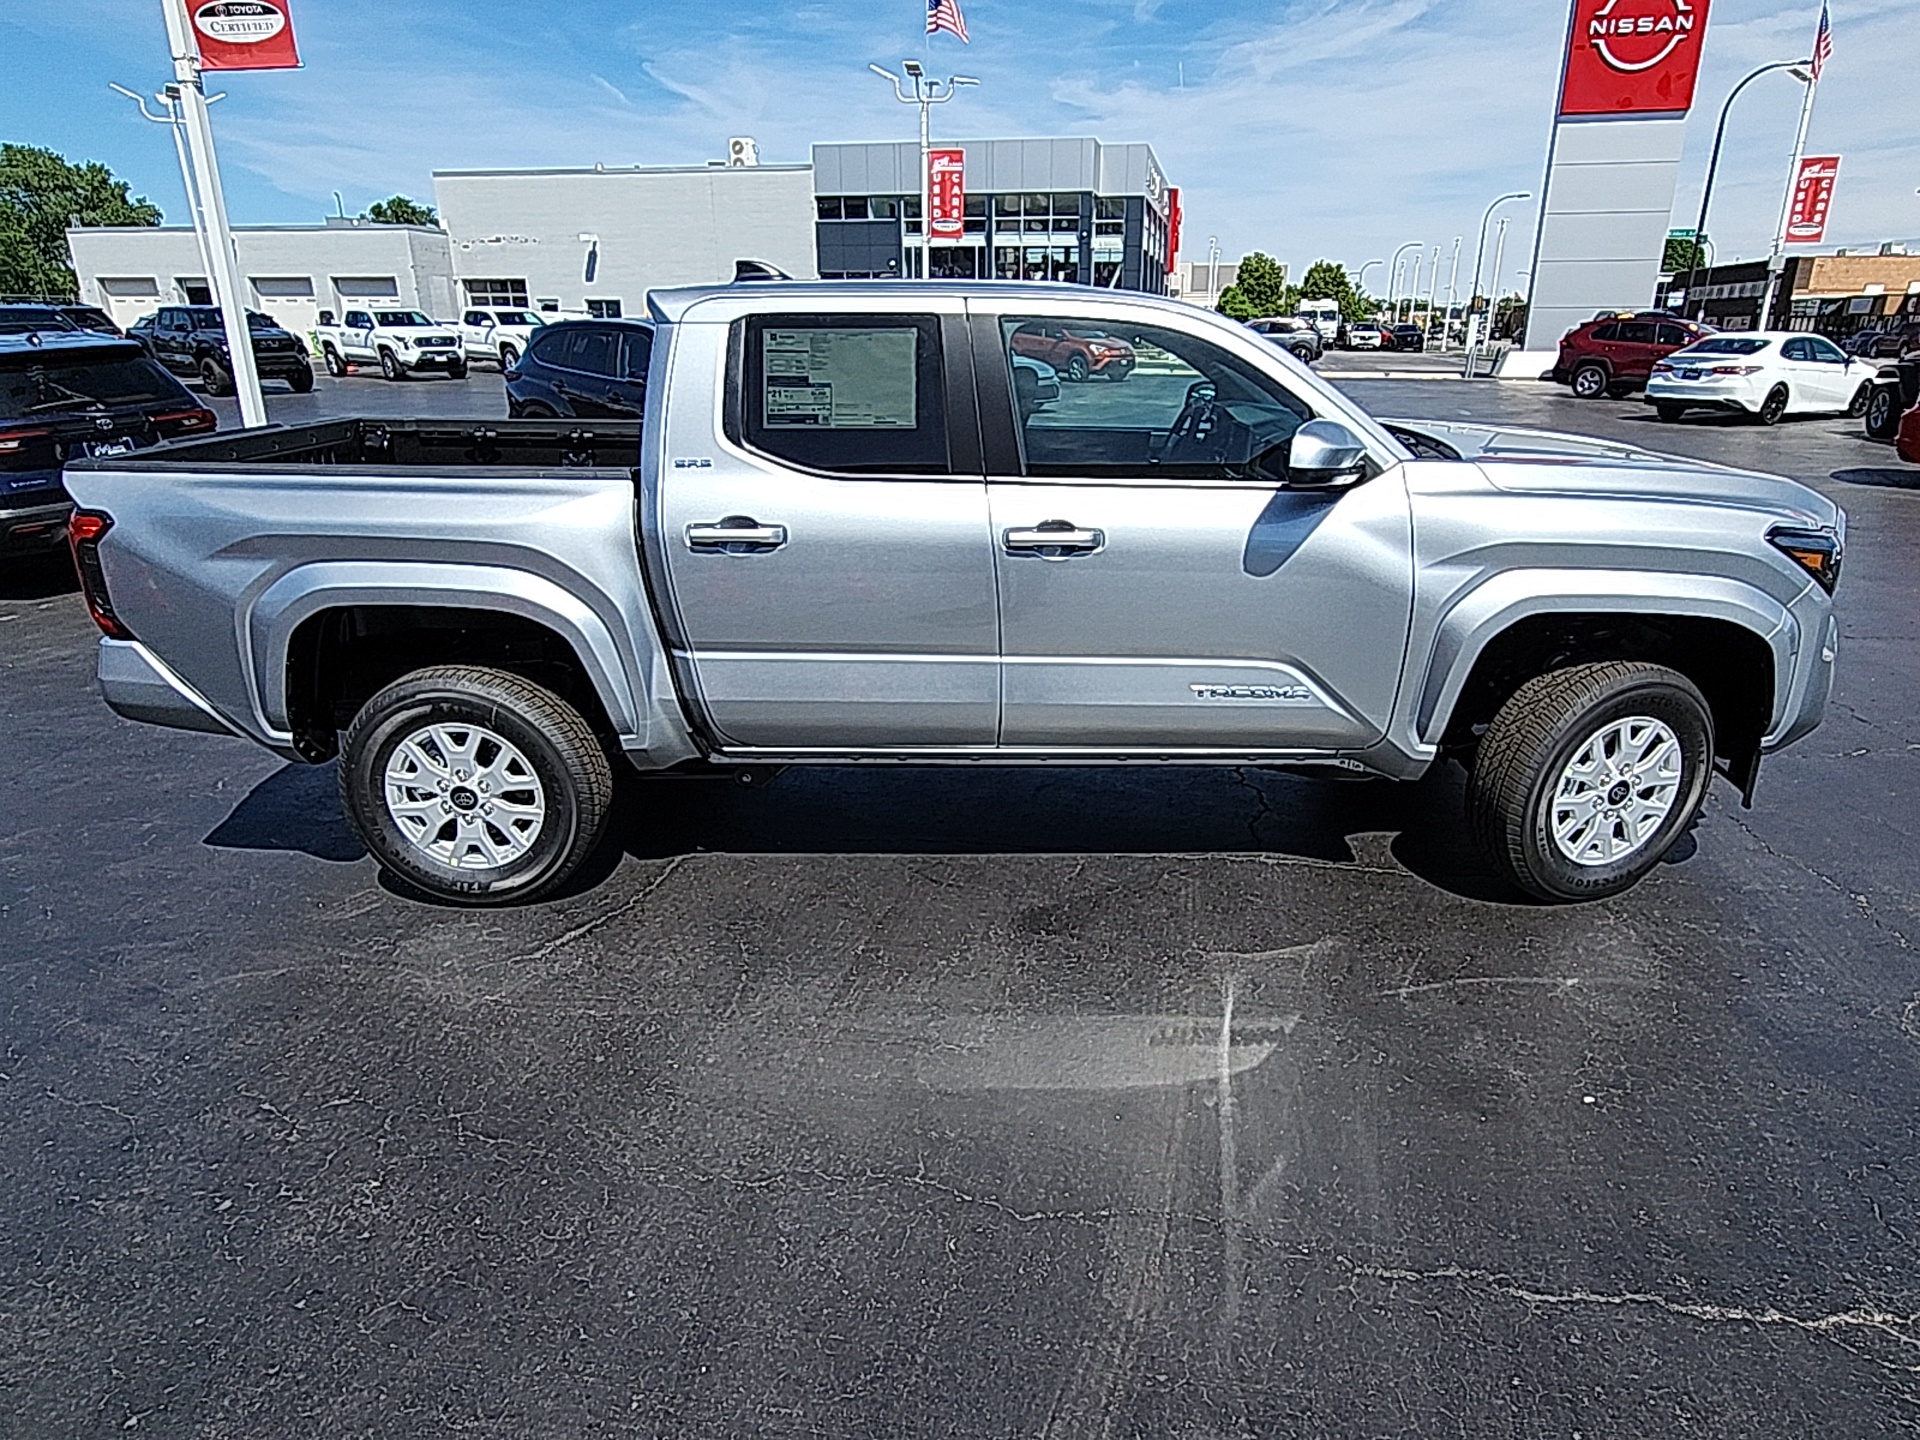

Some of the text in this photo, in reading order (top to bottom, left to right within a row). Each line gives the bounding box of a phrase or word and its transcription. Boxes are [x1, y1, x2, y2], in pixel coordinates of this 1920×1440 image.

[228, 5, 263, 14] TOYOTA
[1590, 14, 1694, 35] NISSAN
[951, 173, 960, 218] CARS
[1792, 180, 1810, 223] USED
[1813, 179, 1831, 222] CARS
[1189, 684, 1311, 699] TACOMA
